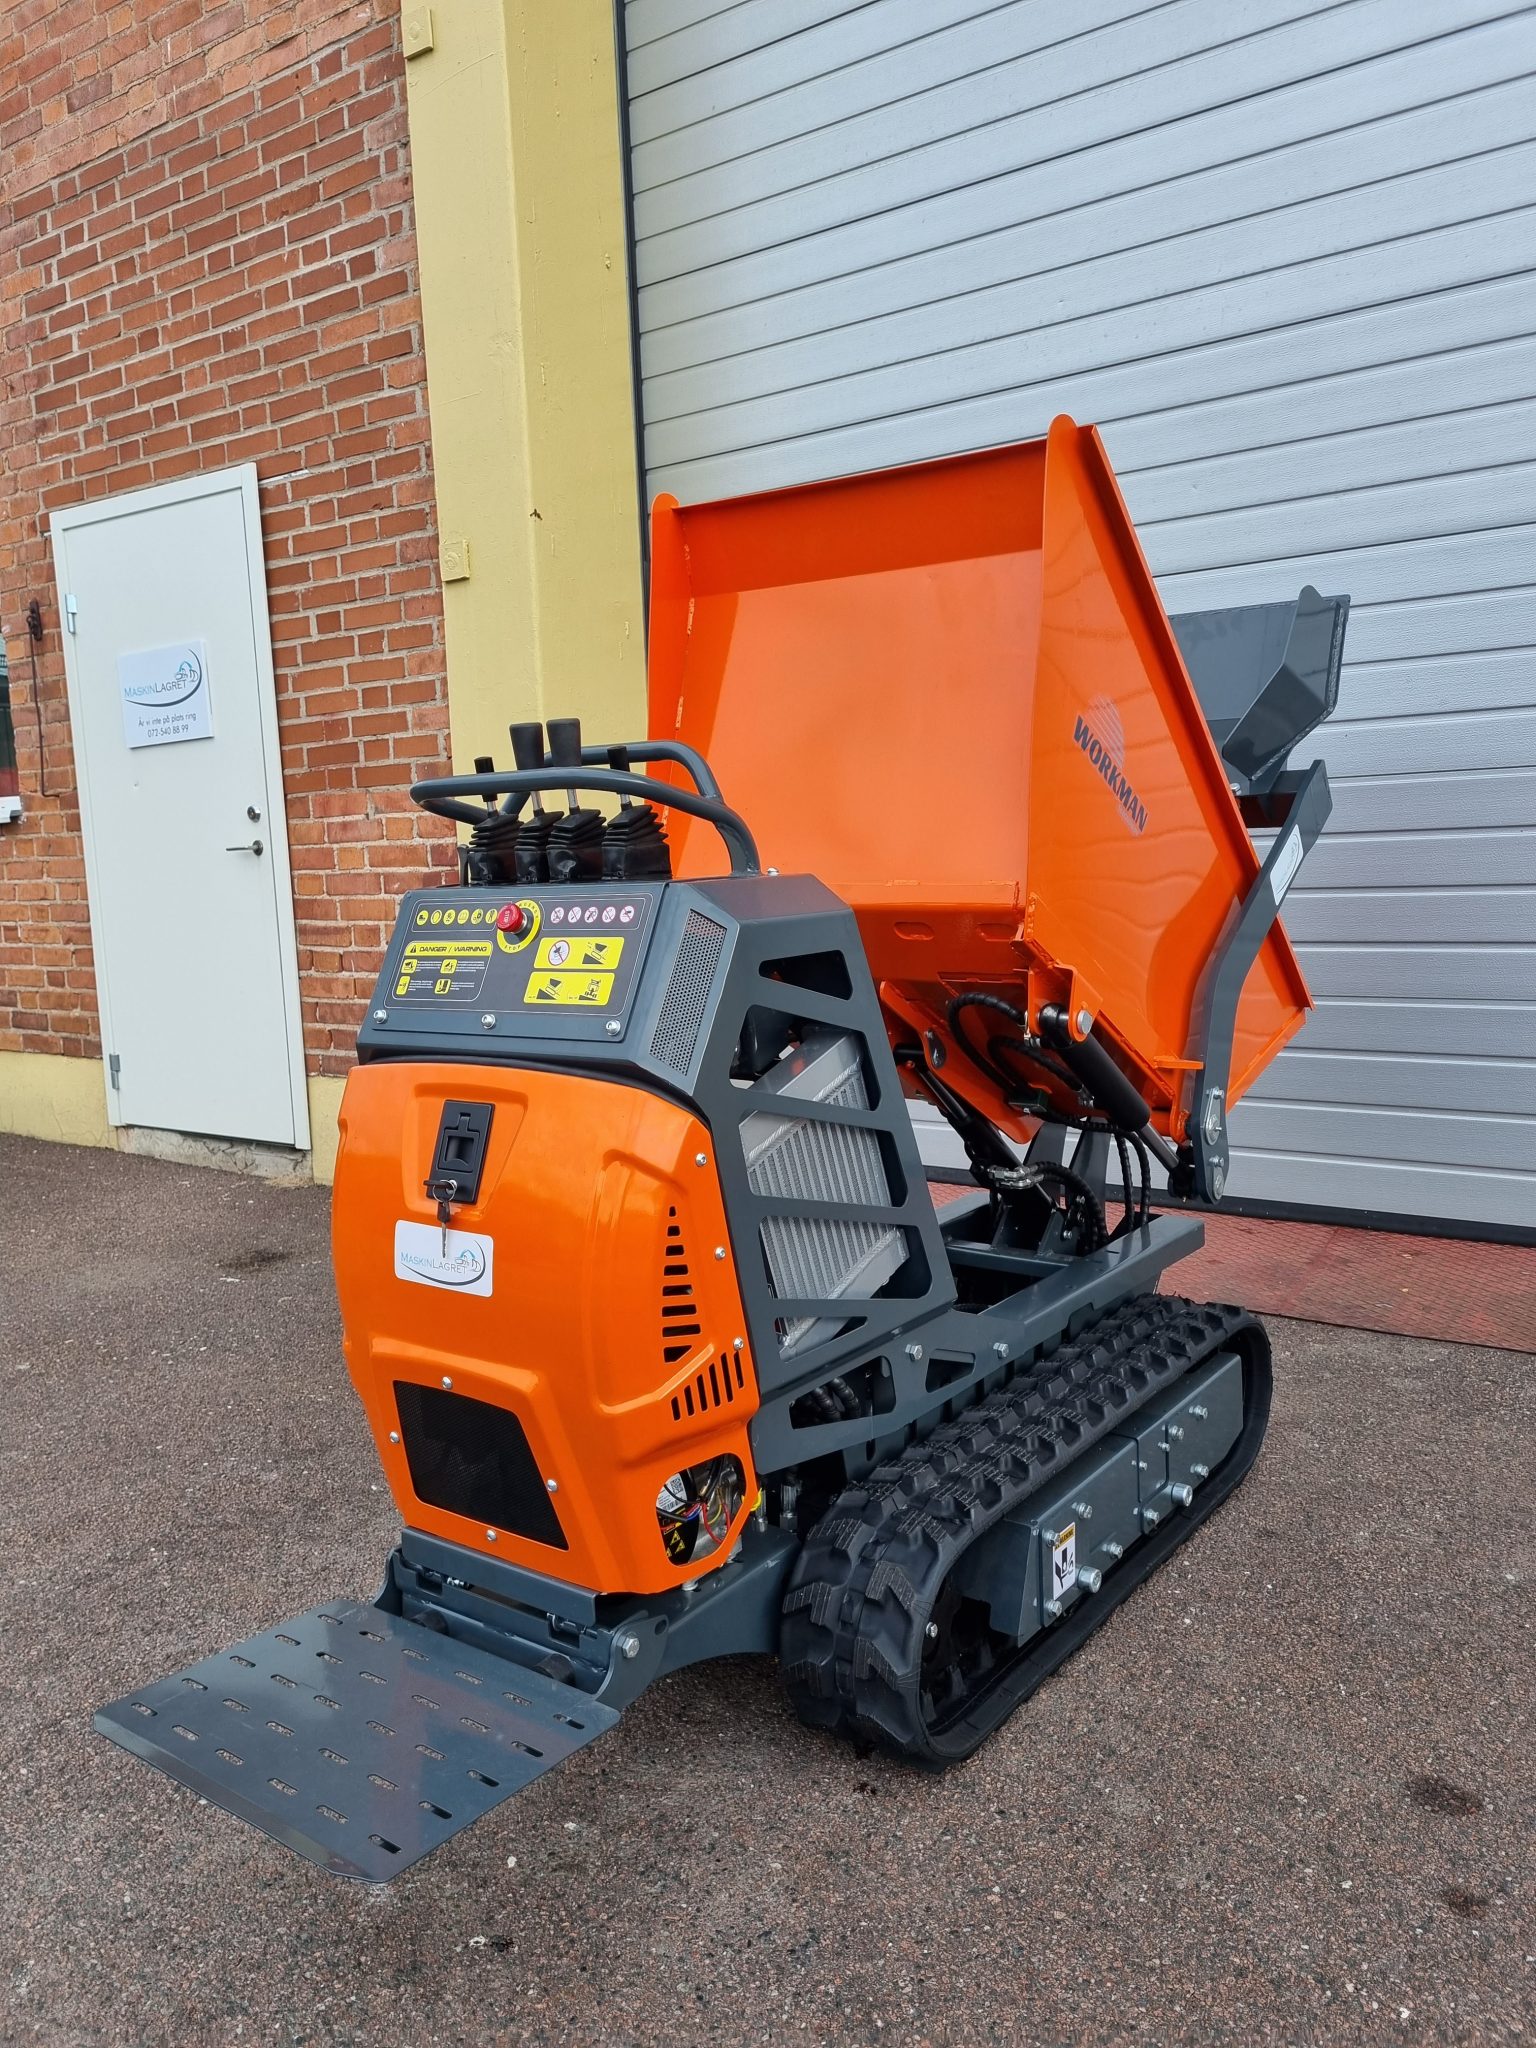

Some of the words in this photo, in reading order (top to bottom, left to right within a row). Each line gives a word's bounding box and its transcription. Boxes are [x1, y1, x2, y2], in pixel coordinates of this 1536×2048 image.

[162, 715, 170, 725] på
[171, 713, 184, 724] plats
[185, 712, 197, 721] ring
[148, 728, 171, 738] 072-540
[172, 725, 181, 734] 88
[181, 724, 189, 733] 99
[1073, 715, 1148, 832] WORKMAN
[401, 1252, 466, 1274] MASKINLAGRET
